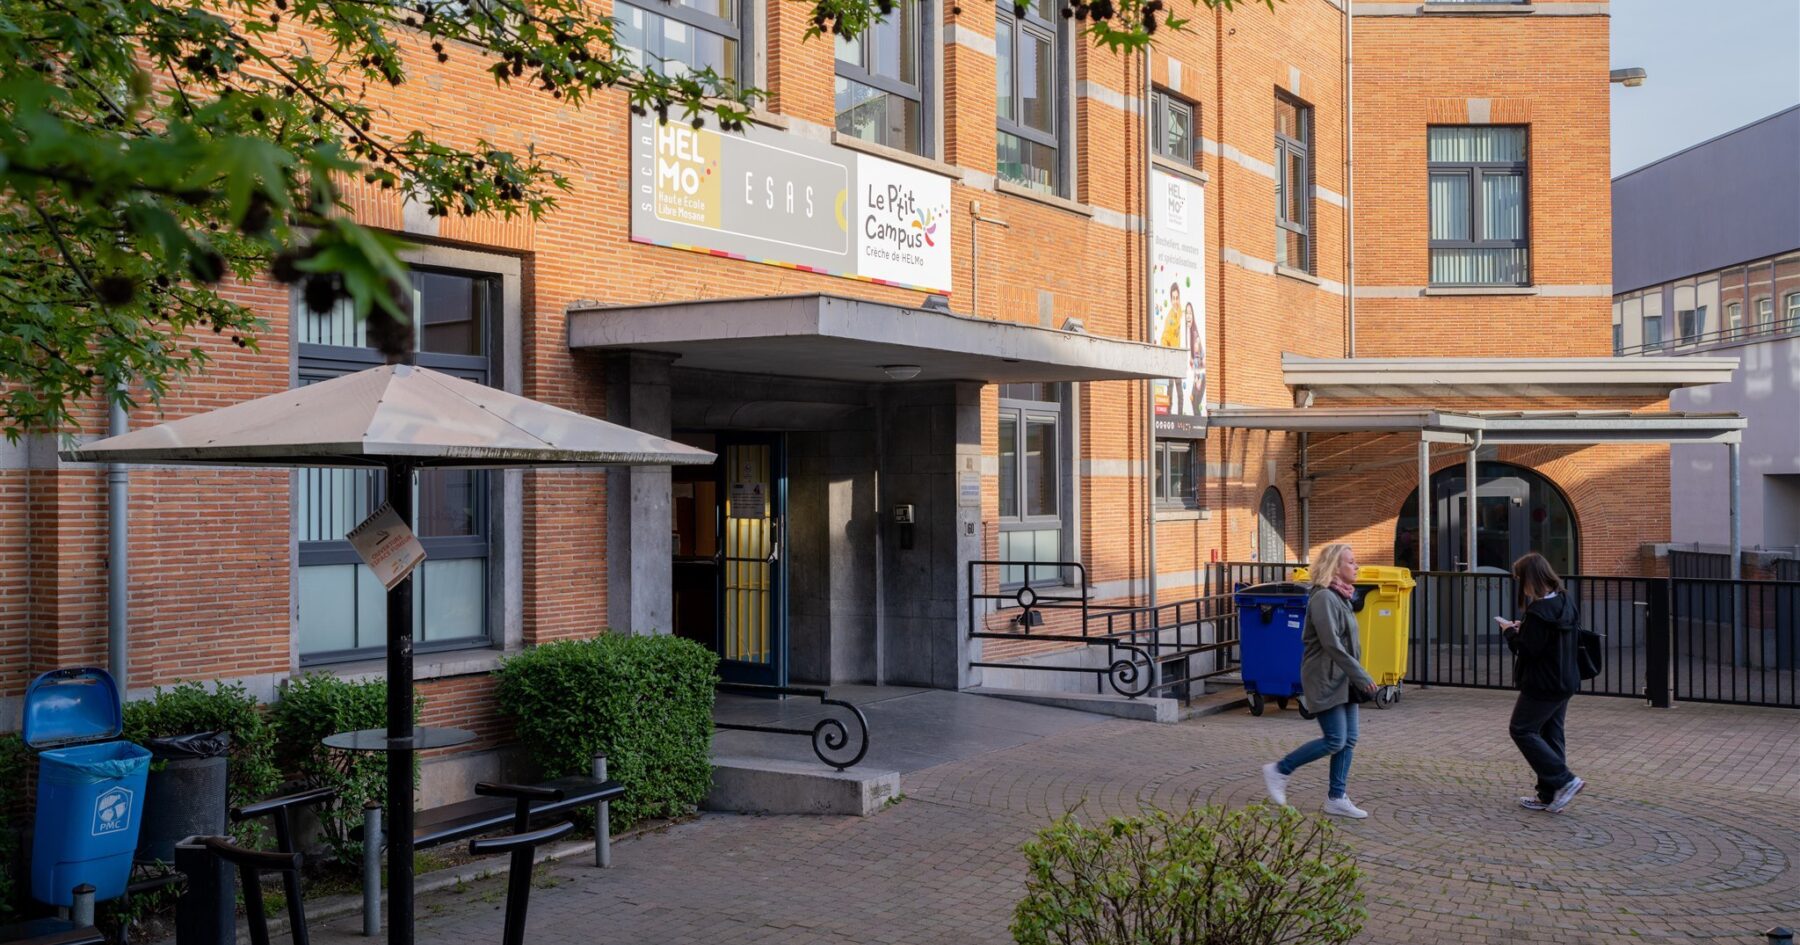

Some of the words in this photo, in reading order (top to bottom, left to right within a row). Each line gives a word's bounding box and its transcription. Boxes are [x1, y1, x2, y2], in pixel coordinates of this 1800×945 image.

[659, 126, 705, 164] HEL
[642, 120, 653, 212] SOCIAL
[659, 157, 699, 195] MO
[659, 190, 683, 206] Haute
[745, 171, 813, 218] ESAS
[868, 184, 885, 210] Le
[887, 184, 916, 222] P'tit
[1168, 183, 1182, 199] HEL
[659, 202, 677, 217] Libre
[678, 207, 705, 222] Mosane
[1168, 198, 1181, 213] MO
[865, 214, 922, 250] Campus
[866, 245, 890, 260] Crèche
[891, 250, 900, 262] de
[902, 253, 924, 266] HELMo
[100, 820, 120, 830] PMC
